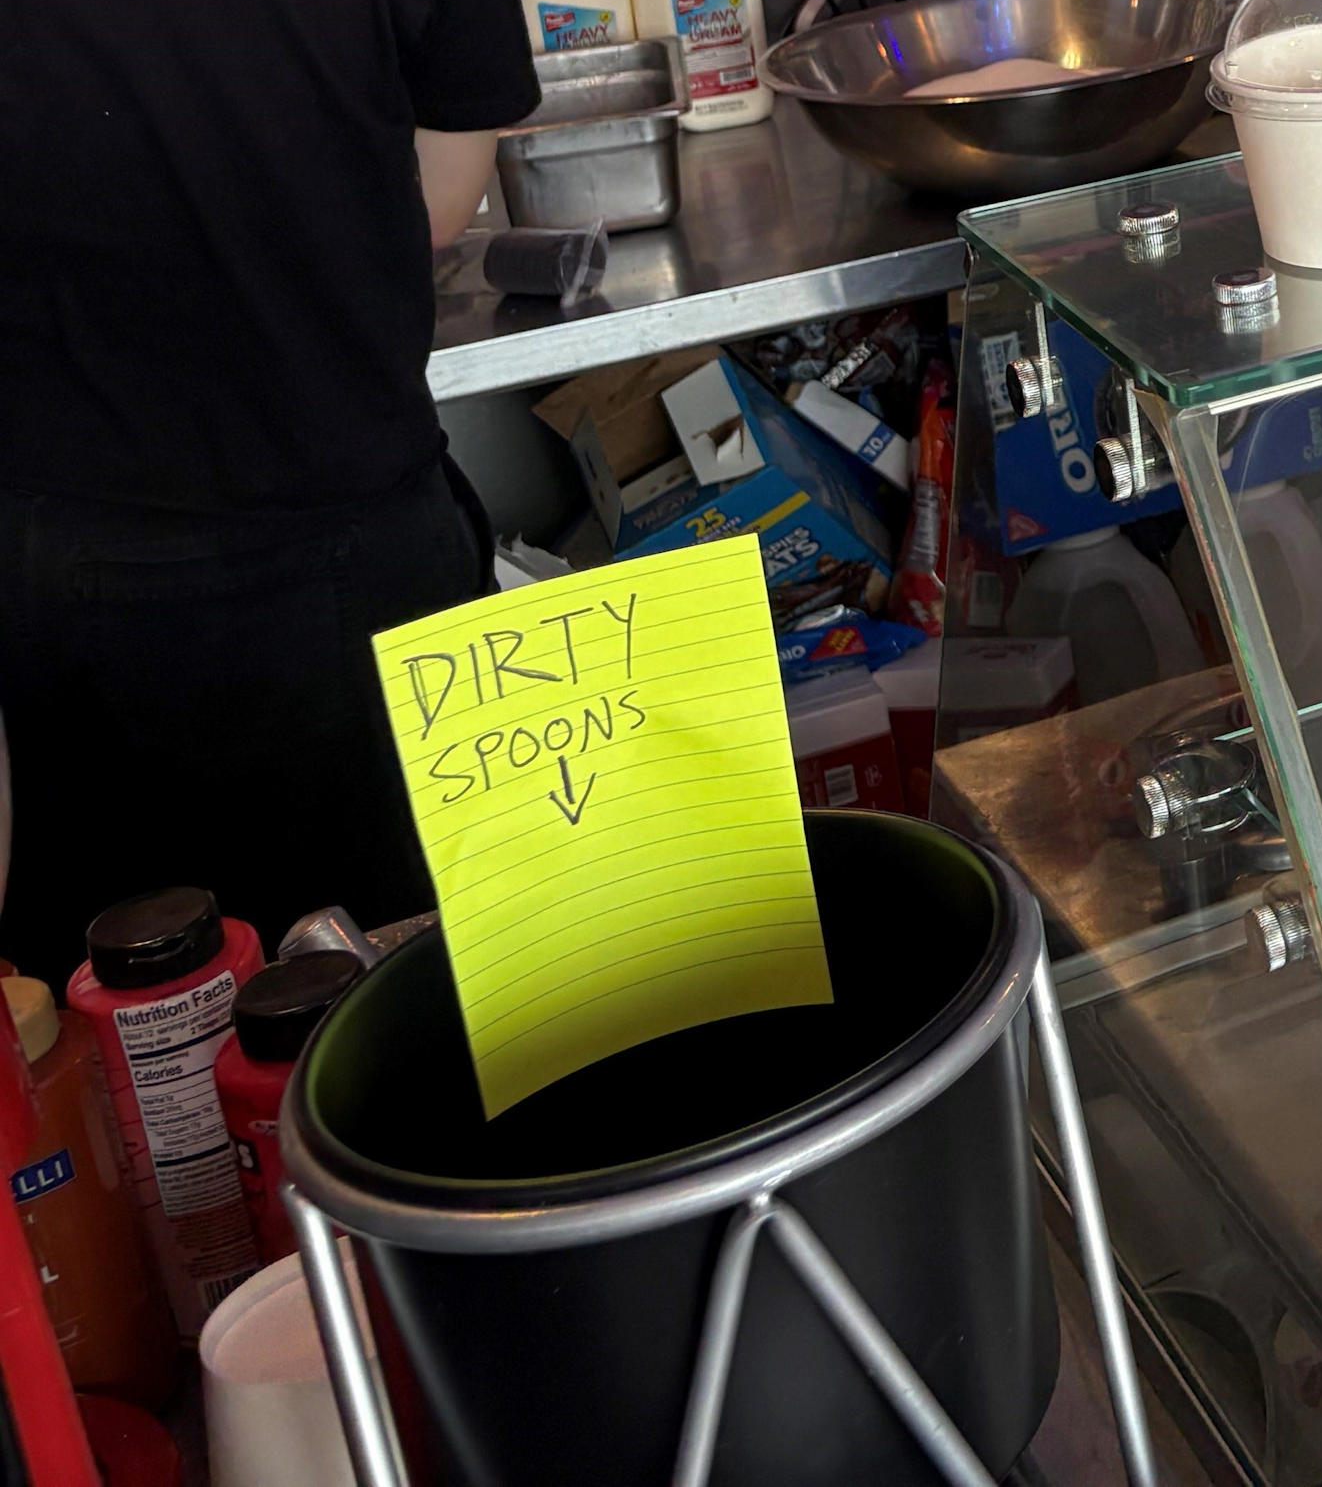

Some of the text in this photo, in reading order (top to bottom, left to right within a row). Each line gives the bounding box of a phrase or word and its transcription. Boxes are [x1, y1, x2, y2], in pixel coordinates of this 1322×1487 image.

[686, 507, 726, 538] 25
[401, 593, 637, 741] DIRTY
[428, 689, 647, 804] SPOONS
[116, 976, 234, 1029] Nutrition Facts
[134, 1065, 184, 1083] Calories
